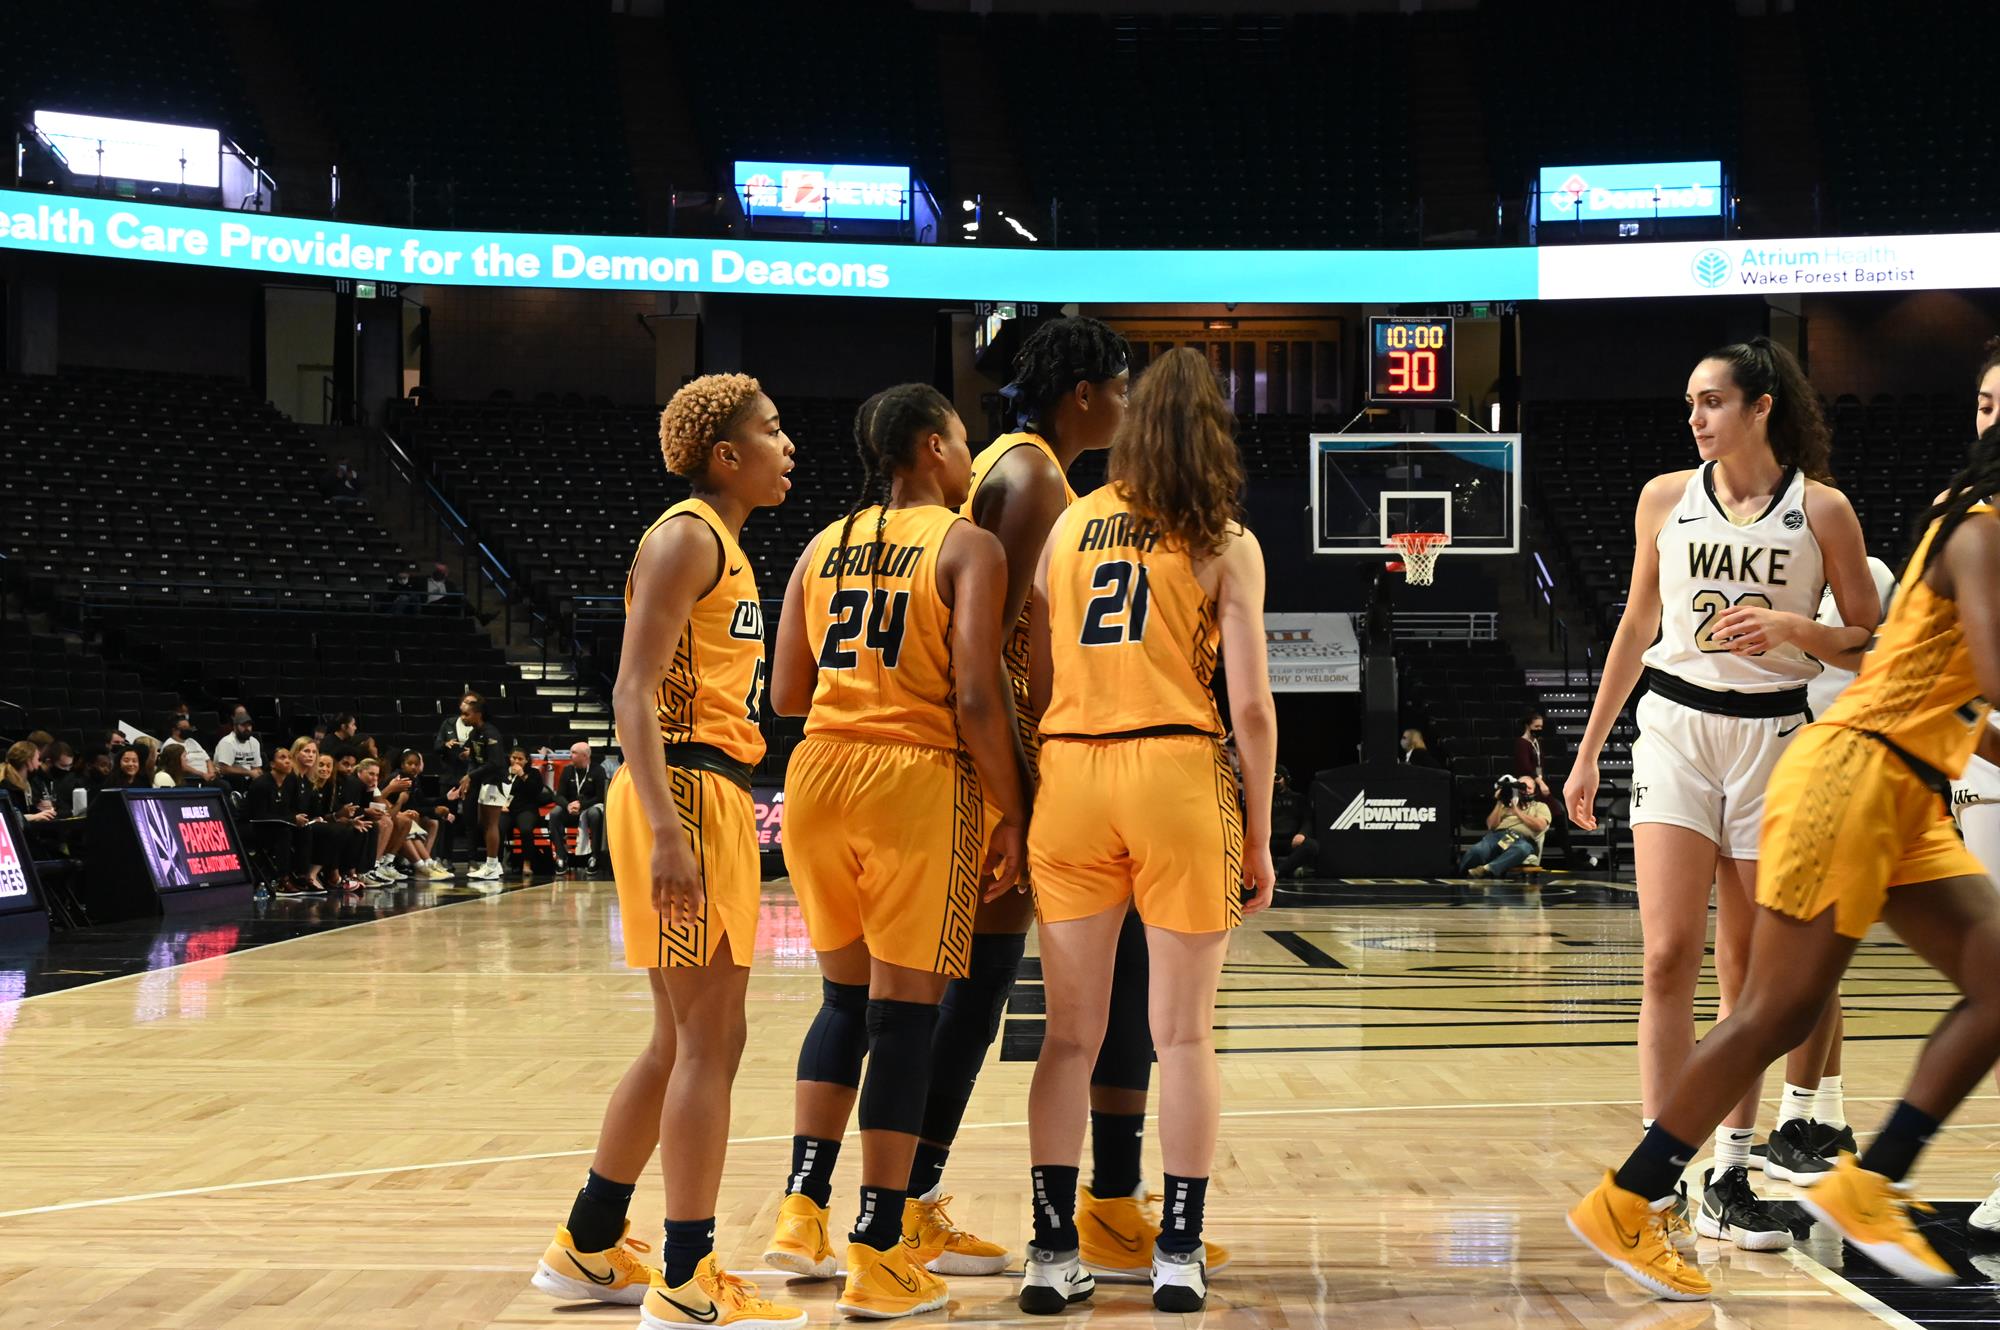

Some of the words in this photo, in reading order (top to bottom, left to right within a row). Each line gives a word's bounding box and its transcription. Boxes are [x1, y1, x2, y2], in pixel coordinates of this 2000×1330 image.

[827, 181, 902, 206] NEWS
[107, 212, 208, 255] Care
[220, 222, 391, 271] Provider
[402, 240, 462, 276] for
[471, 243, 541, 279] the
[552, 244, 699, 283] Demon
[711, 249, 890, 289] Deacons
[1741, 247, 1820, 267] Atrium
[1824, 244, 1897, 265] Health
[381, 283, 397, 298] 112
[1741, 271, 1789, 286] Wake
[1795, 269, 1849, 284] Forest
[1855, 267, 1916, 284] Baptist
[1387, 325, 1444, 349] 10:00
[1388, 351, 1436, 392] 30
[819, 541, 925, 579] BROWN
[1688, 541, 1791, 587] WAKE
[1078, 559, 1150, 647] 21
[818, 587, 911, 670] 24
[1330, 789, 1437, 830] ADVANTAGE
[178, 820, 231, 854] PARRISH
